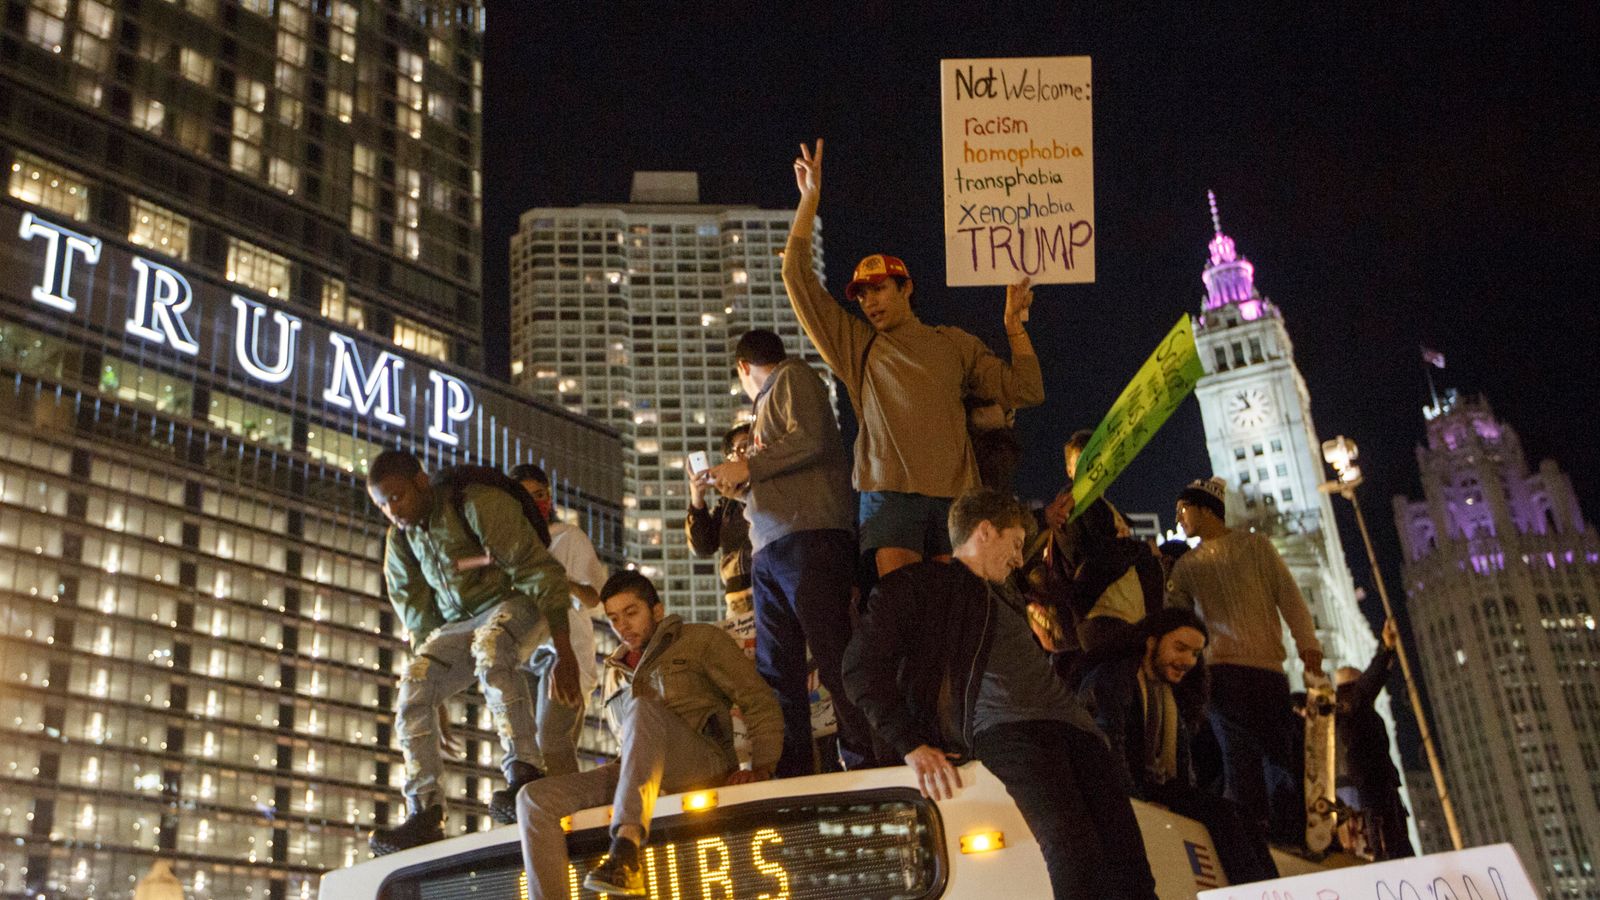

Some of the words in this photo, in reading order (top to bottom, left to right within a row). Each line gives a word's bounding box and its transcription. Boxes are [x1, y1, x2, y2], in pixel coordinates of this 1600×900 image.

[955, 66, 998, 100] Not
[1001, 68, 1091, 103] Welcome:
[964, 116, 1029, 136] racism
[963, 138, 1084, 168] homophobia
[954, 168, 1063, 196] transphobia
[957, 220, 1093, 276] TRUMP
[18, 211, 475, 446] TRUMP
